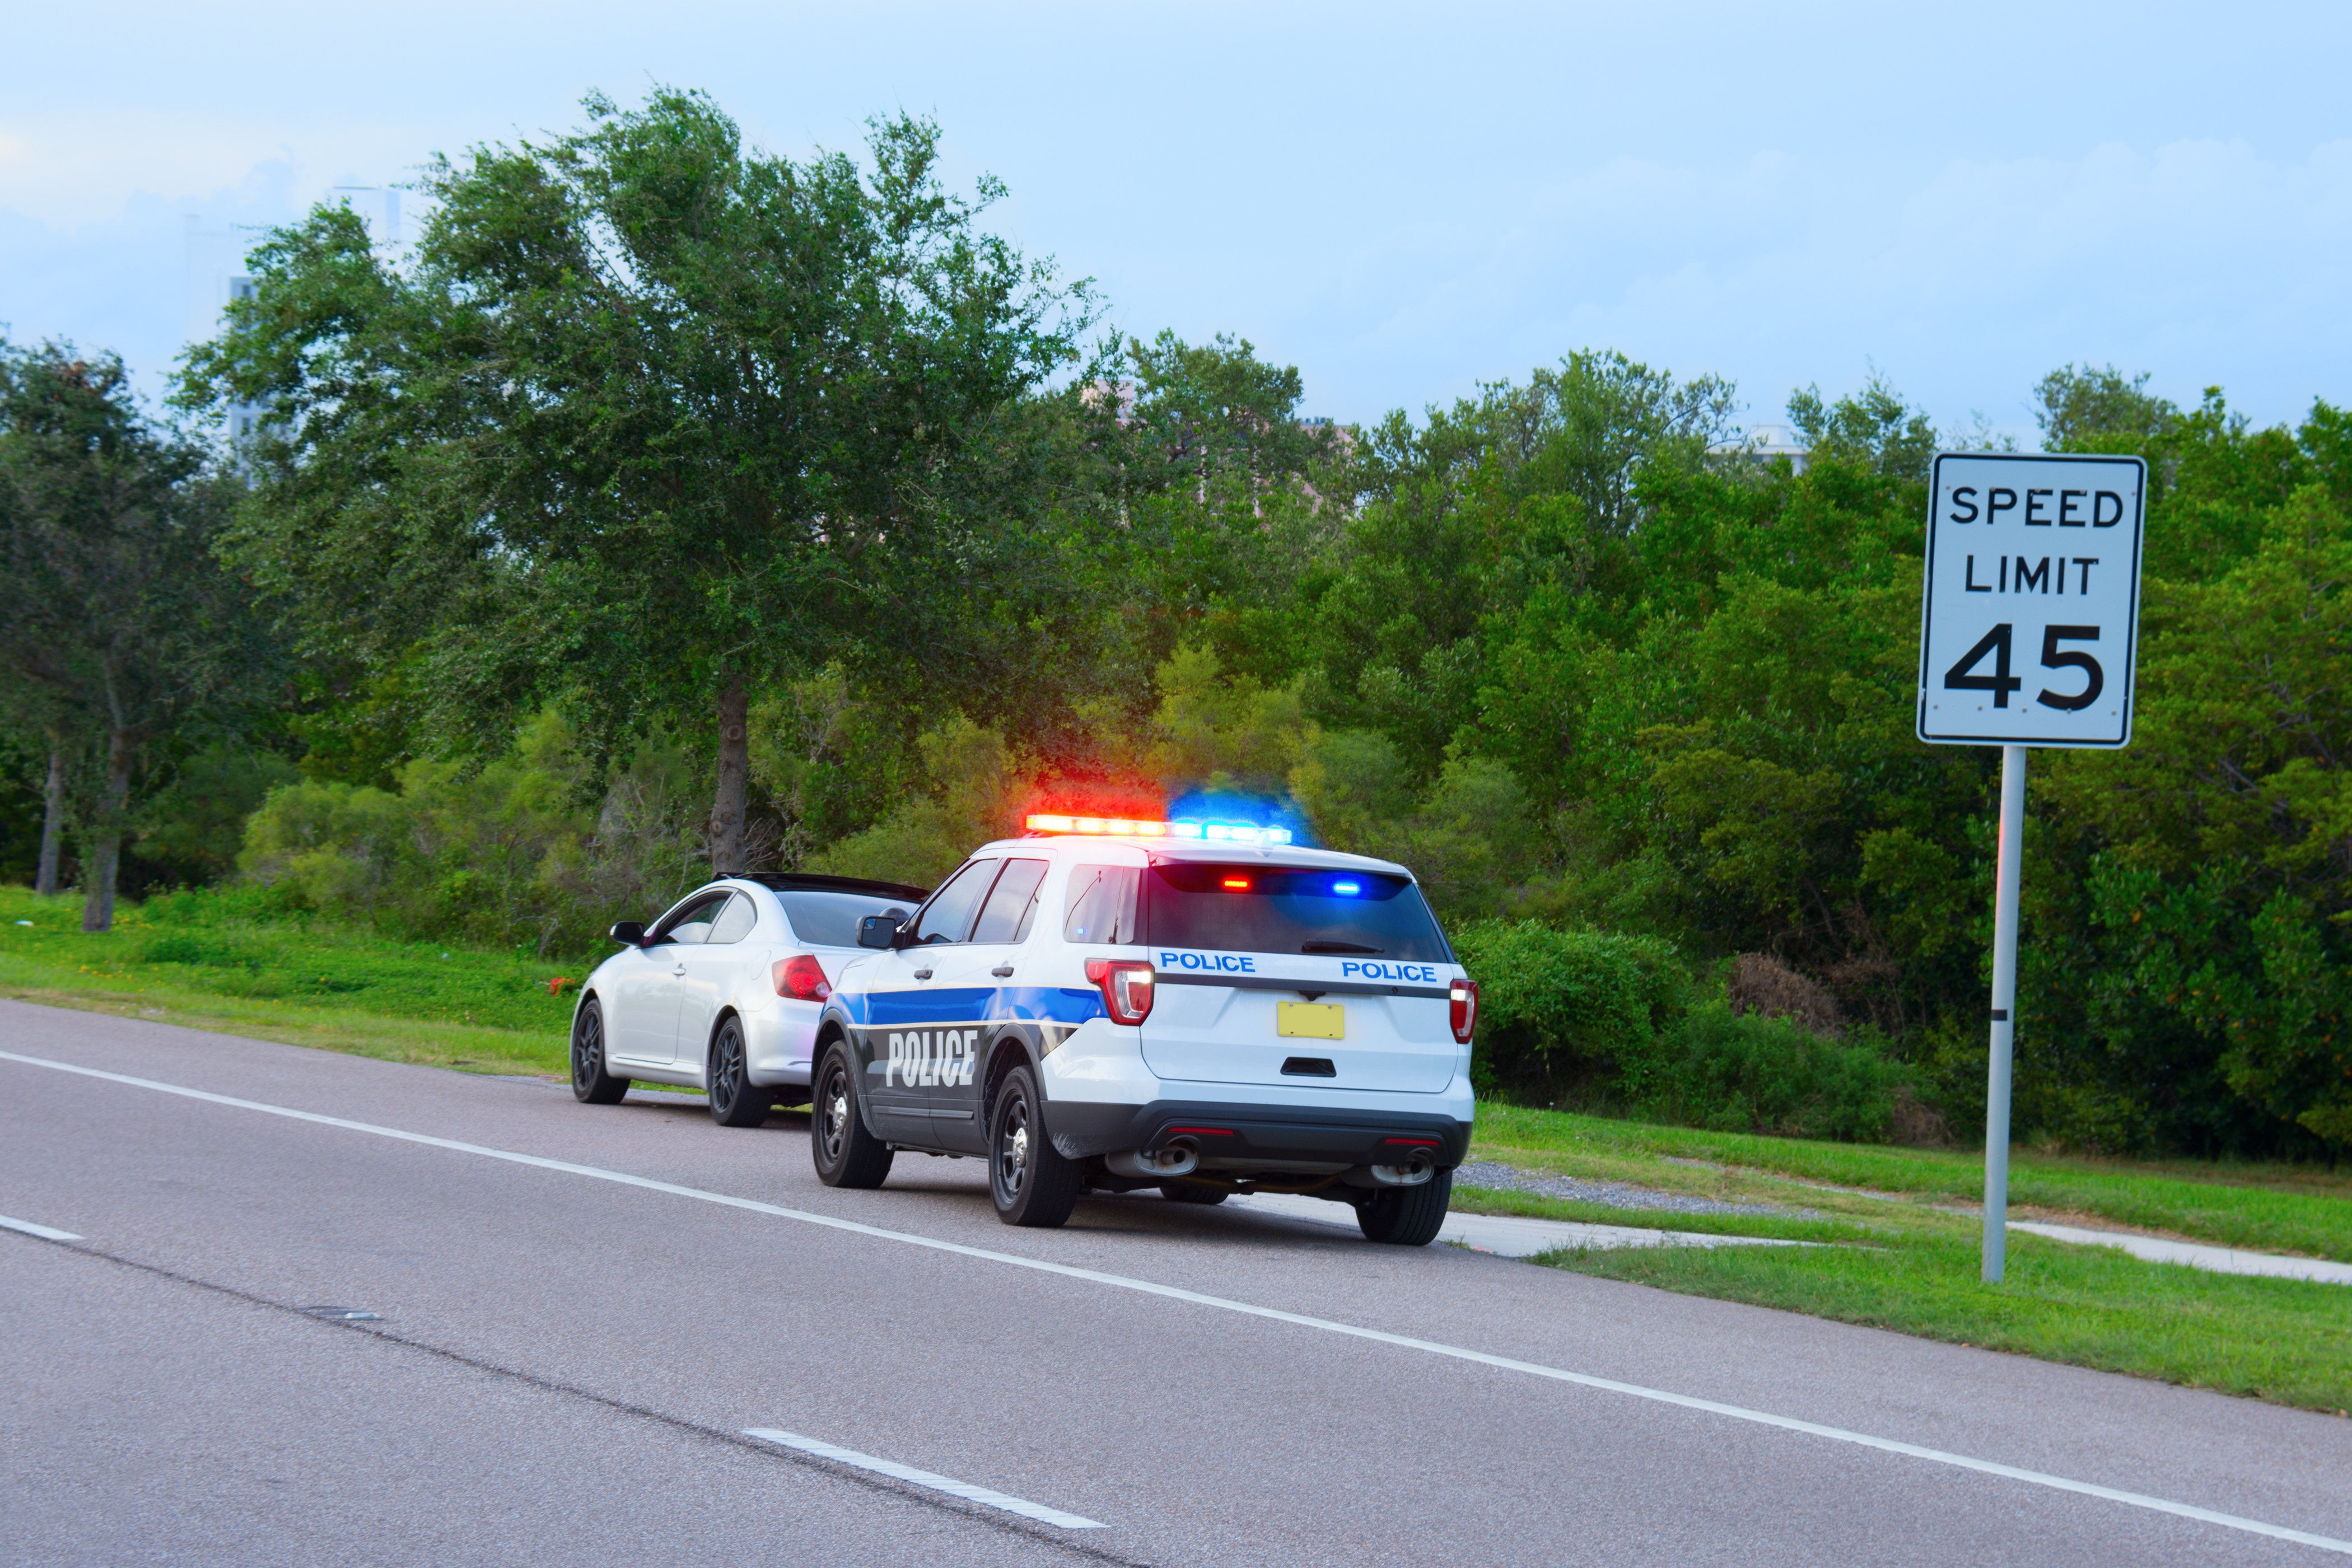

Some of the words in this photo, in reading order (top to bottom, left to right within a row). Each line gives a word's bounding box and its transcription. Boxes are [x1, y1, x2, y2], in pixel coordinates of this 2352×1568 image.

[1949, 486, 2123, 528] SPEED
[1965, 554, 2099, 595] LIMIT
[1944, 623, 2104, 711] 45
[1160, 952, 1256, 973] POLICE
[1342, 962, 1438, 982] POLICE
[885, 1029, 978, 1087] POLICE
